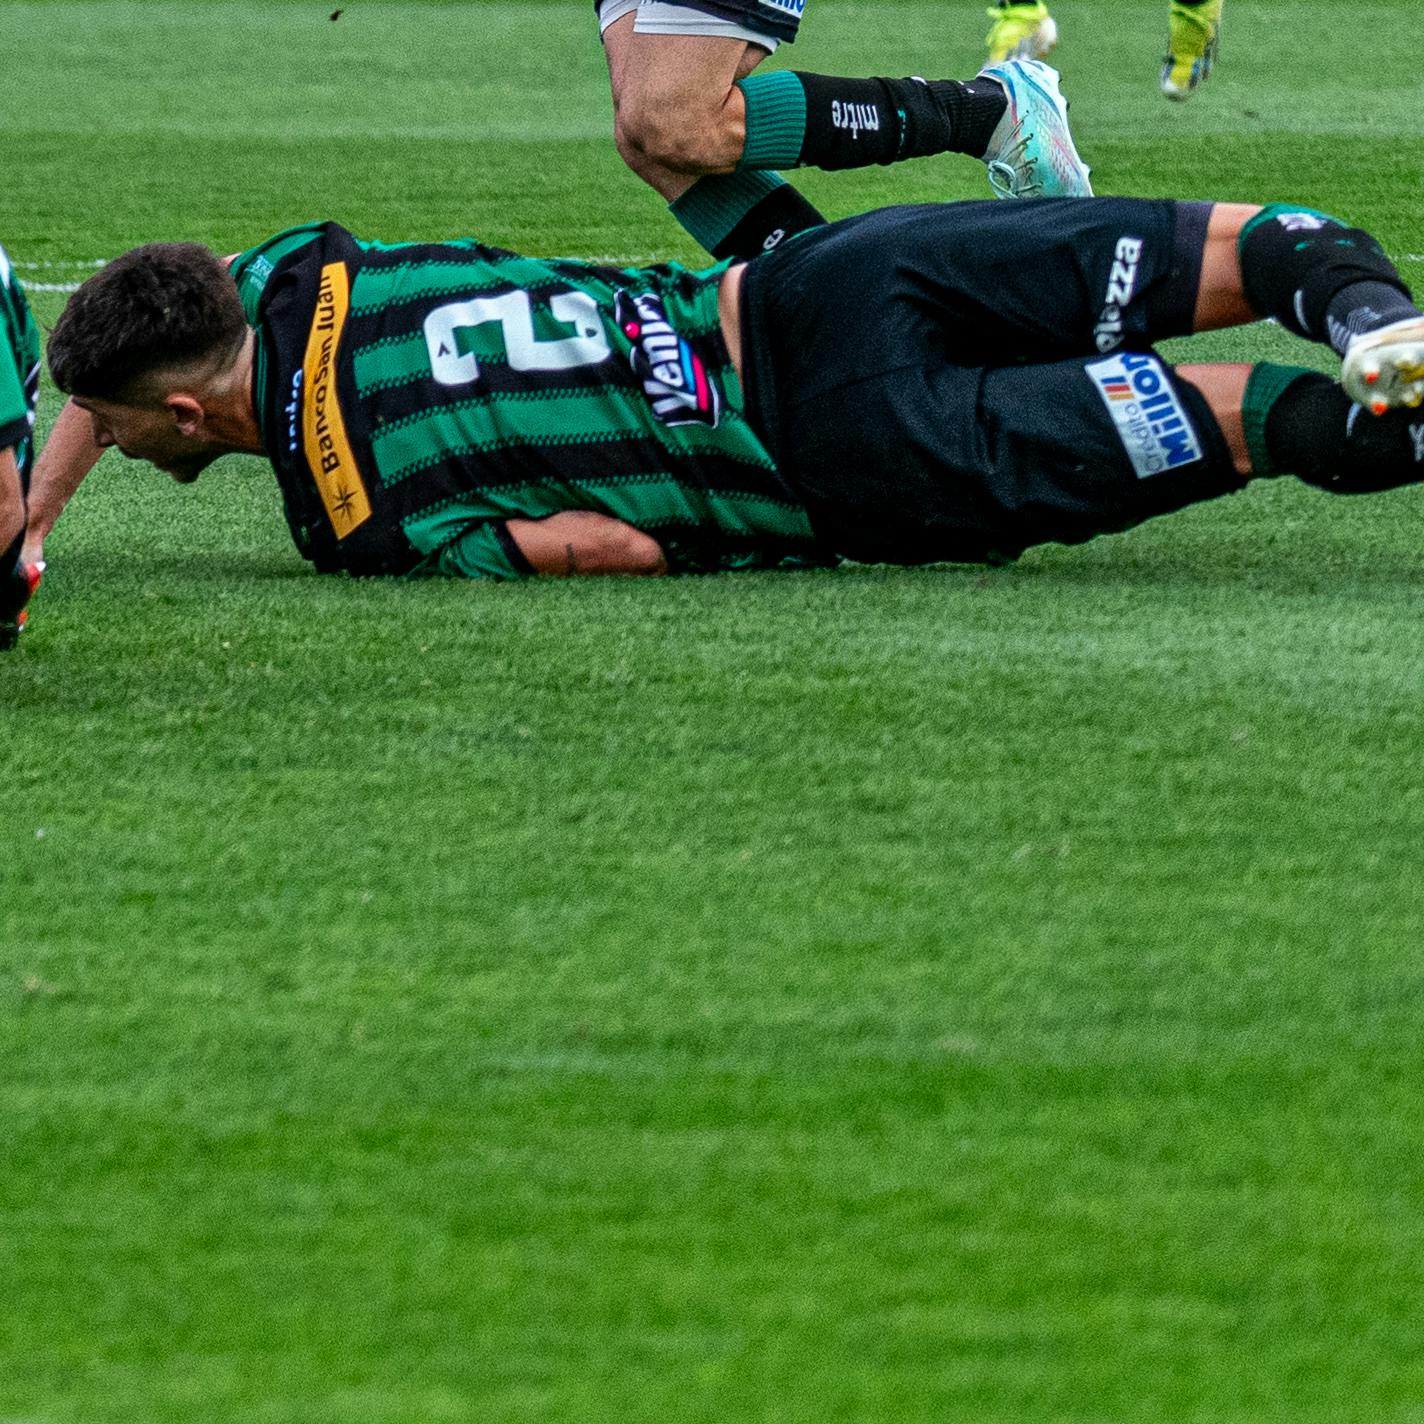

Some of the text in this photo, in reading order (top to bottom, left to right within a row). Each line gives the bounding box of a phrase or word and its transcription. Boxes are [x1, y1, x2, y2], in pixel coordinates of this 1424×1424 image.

[831, 98, 880, 139] mitre
[314, 333, 333, 384] San
[423, 289, 612, 385] 2
[314, 384, 341, 475] Banco
